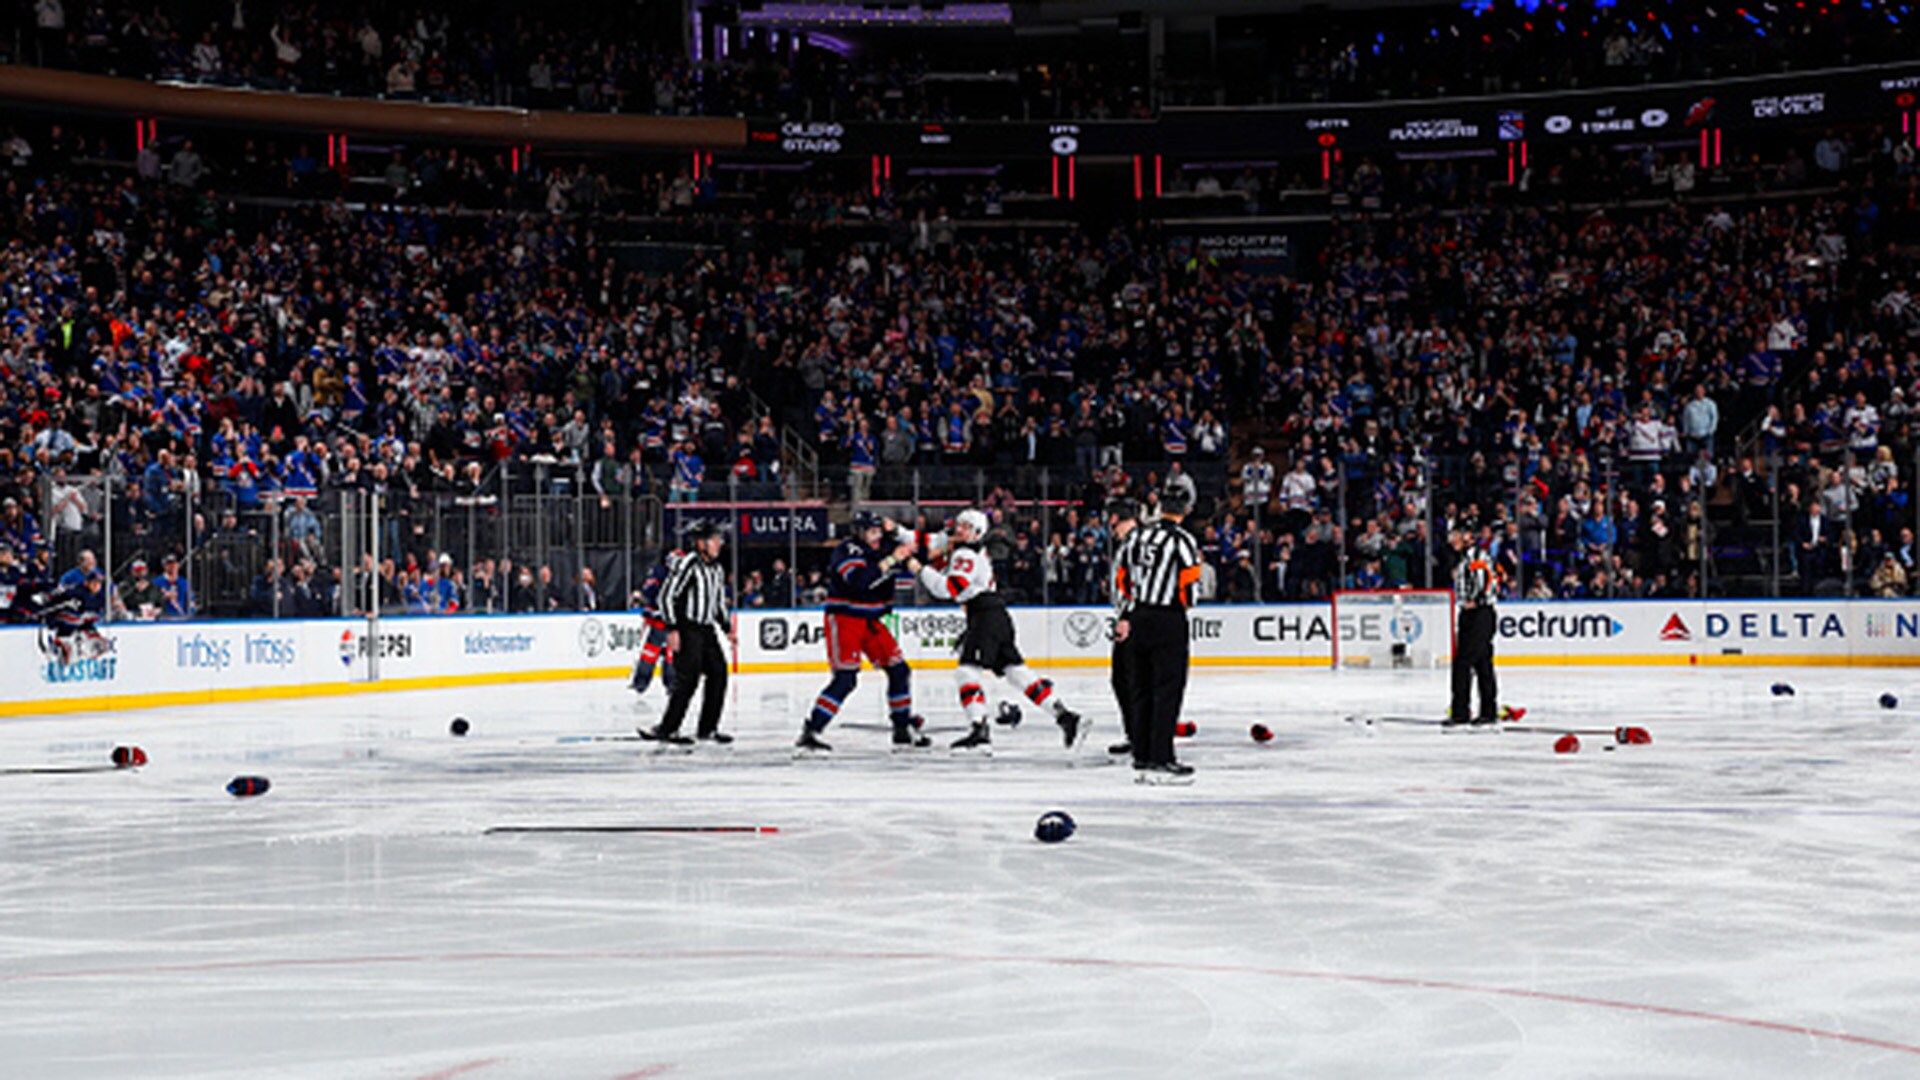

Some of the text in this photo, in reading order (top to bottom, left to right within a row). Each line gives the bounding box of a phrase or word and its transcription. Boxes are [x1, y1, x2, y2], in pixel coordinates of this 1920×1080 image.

[1754, 100, 1823, 117] DEVILS
[782, 138, 841, 152] STARS
[1228, 236, 1267, 246] QUIT
[753, 516, 817, 532] ULTRA
[1253, 615, 1381, 641] CHASE
[1499, 610, 1611, 638] ectrum
[1706, 613, 1844, 638] DELTA
[464, 631, 533, 654] ticketmaster
